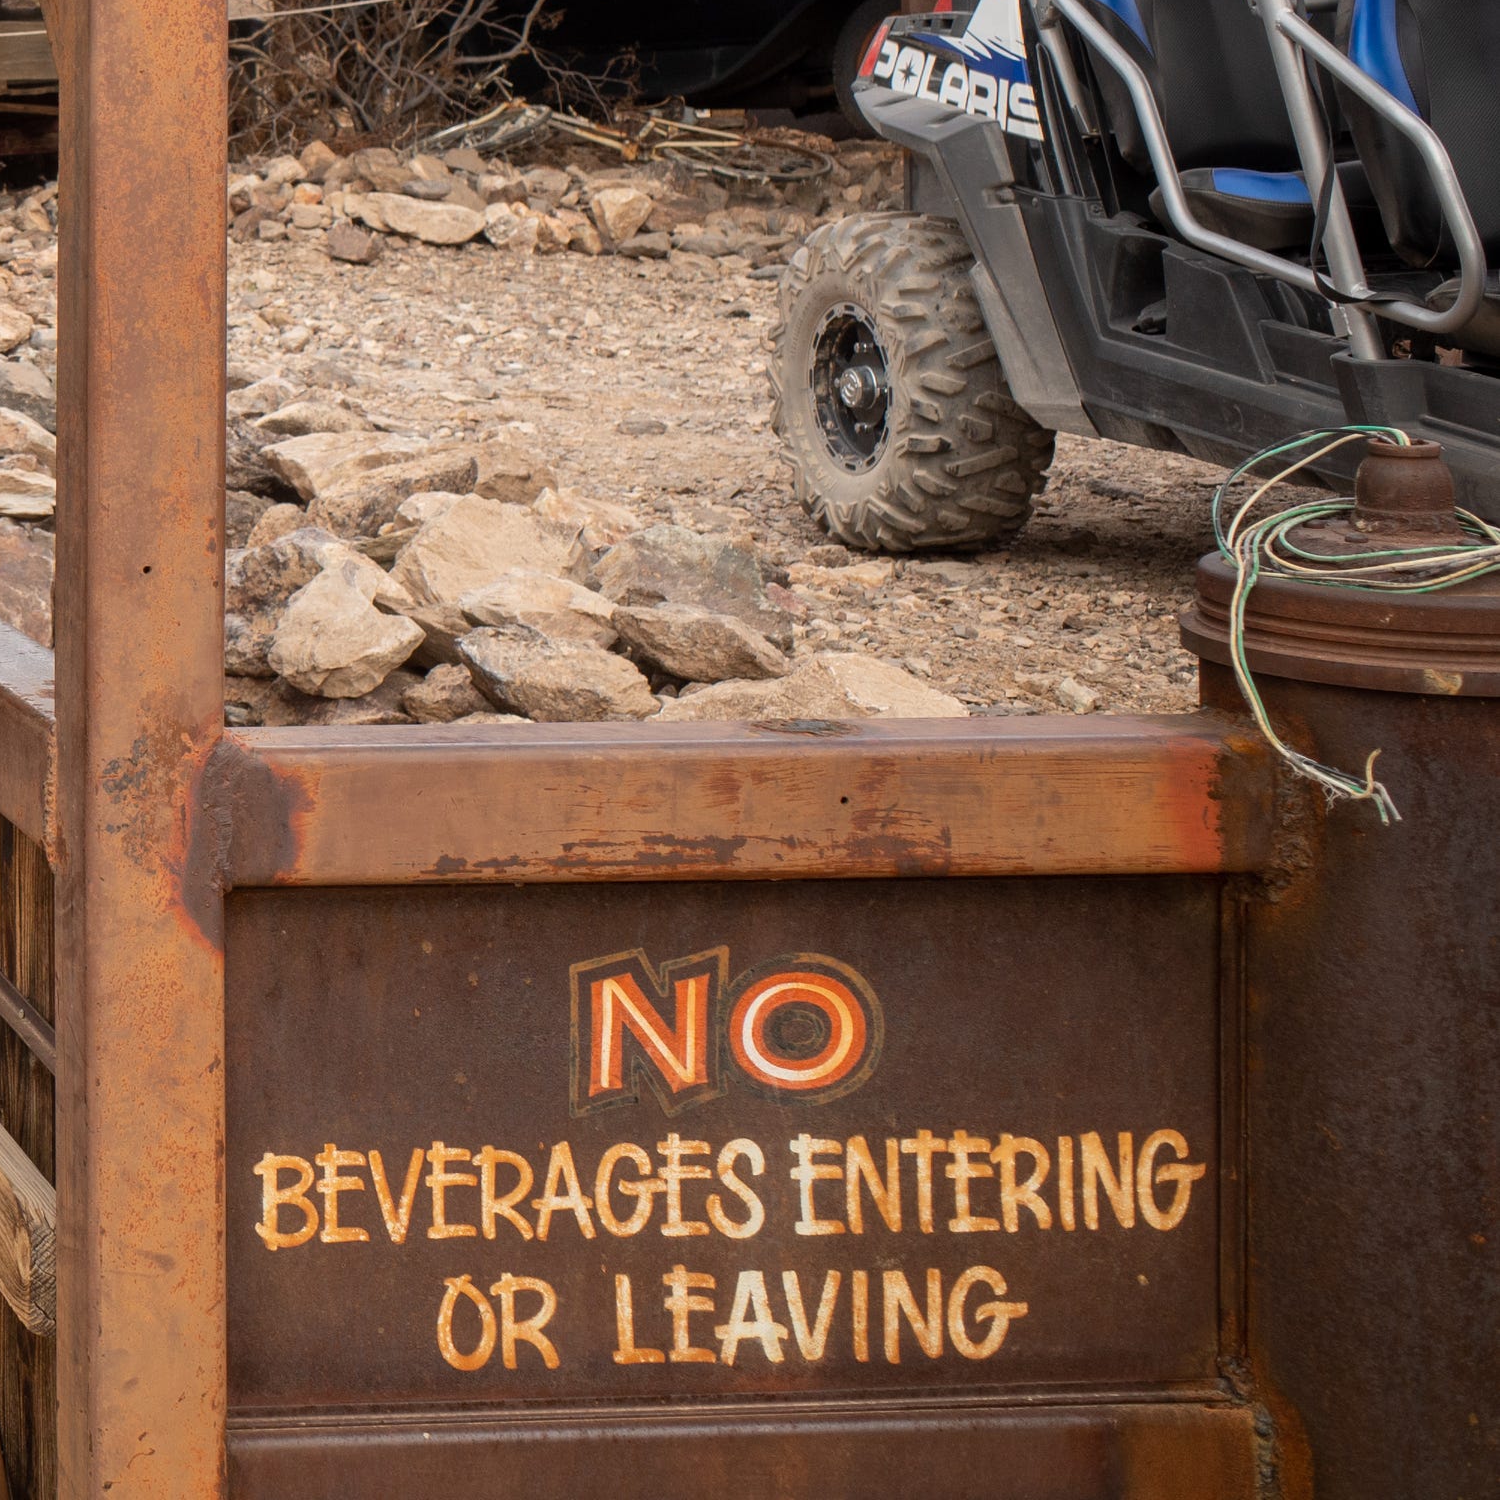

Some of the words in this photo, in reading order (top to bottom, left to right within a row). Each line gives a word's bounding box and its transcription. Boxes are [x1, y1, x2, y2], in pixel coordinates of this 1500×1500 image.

[873, 39, 1045, 141] POLARIS
[578, 954, 876, 1108] NO
[254, 1132, 766, 1251] BEVERAGES
[793, 1128, 1207, 1237] ENTERING
[436, 1271, 560, 1371] OR
[613, 1263, 1029, 1365] LEAVING
